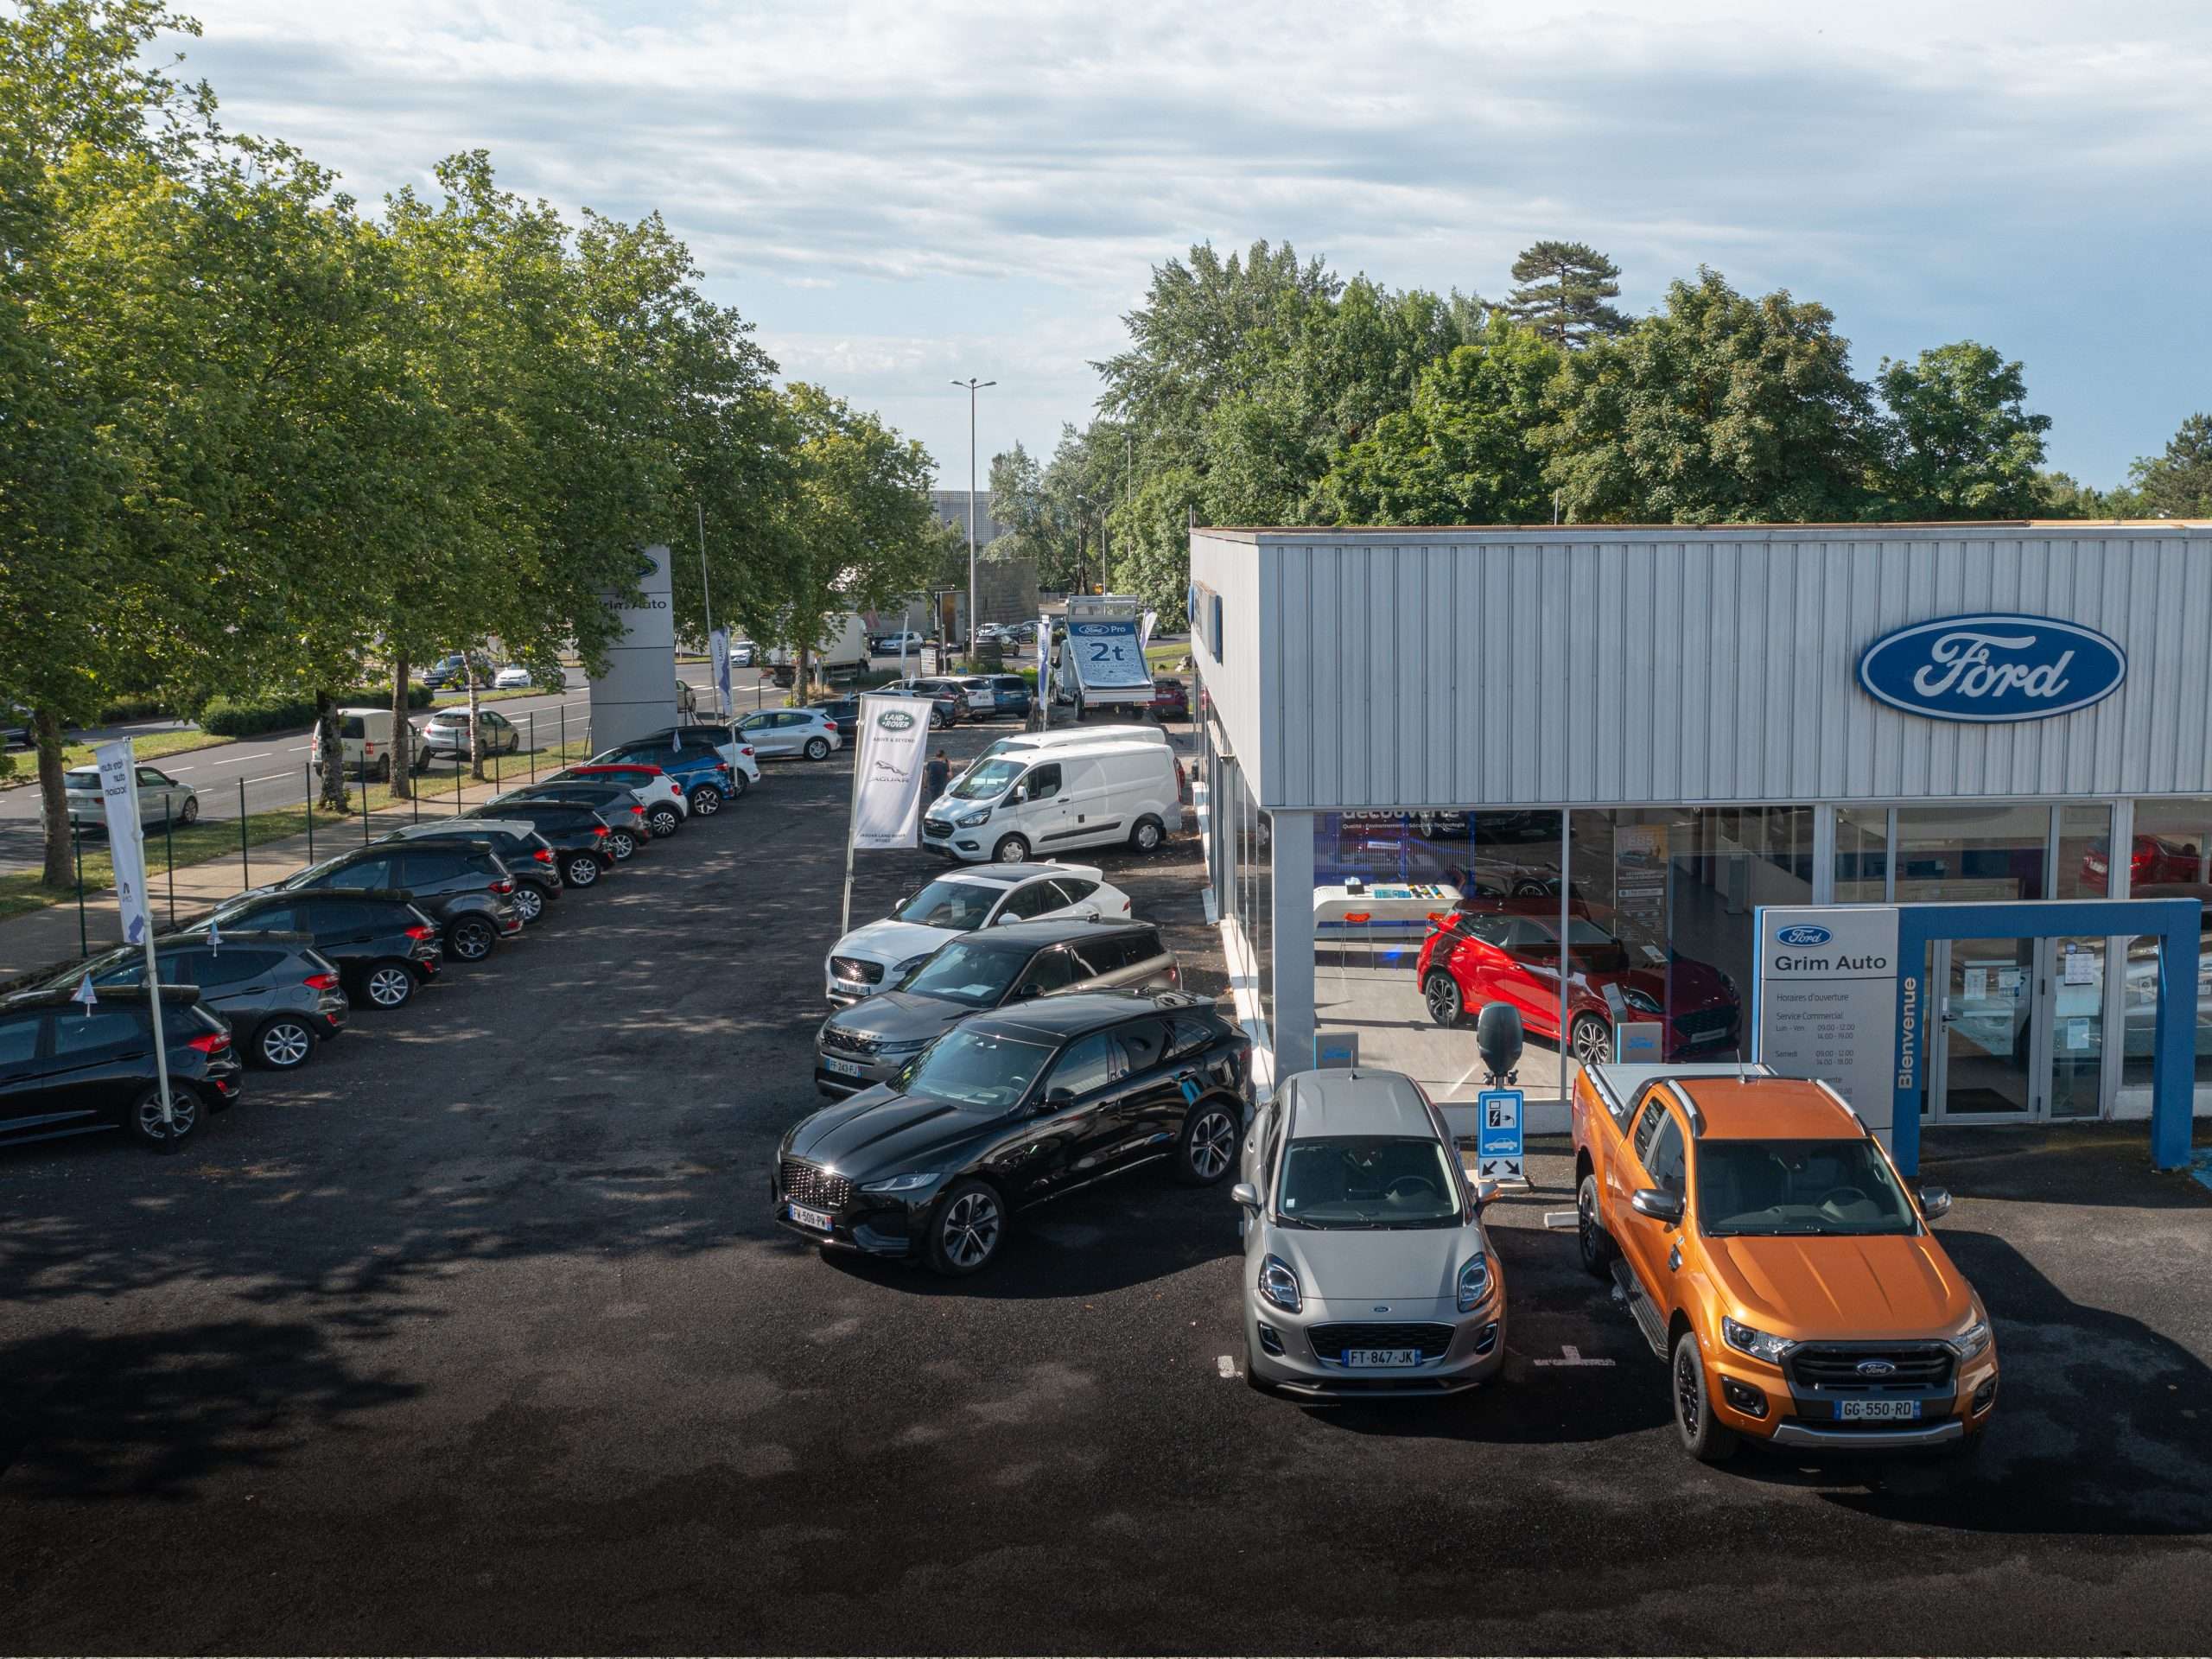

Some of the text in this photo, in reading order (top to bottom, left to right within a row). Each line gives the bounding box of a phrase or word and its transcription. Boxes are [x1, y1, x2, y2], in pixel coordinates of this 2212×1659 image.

[1089, 642, 1125, 662] 2t
[1912, 632, 2075, 698] Ford
[1775, 955, 1887, 971] Grim Auto
[1777, 993, 1807, 1002] Horaires
[1776, 1012, 1801, 1020] Service
[1898, 976, 1916, 1089] Bienvenue
[1351, 1351, 1414, 1365] FT-847-JK
[1843, 1401, 1912, 1417] GG-550-RD
